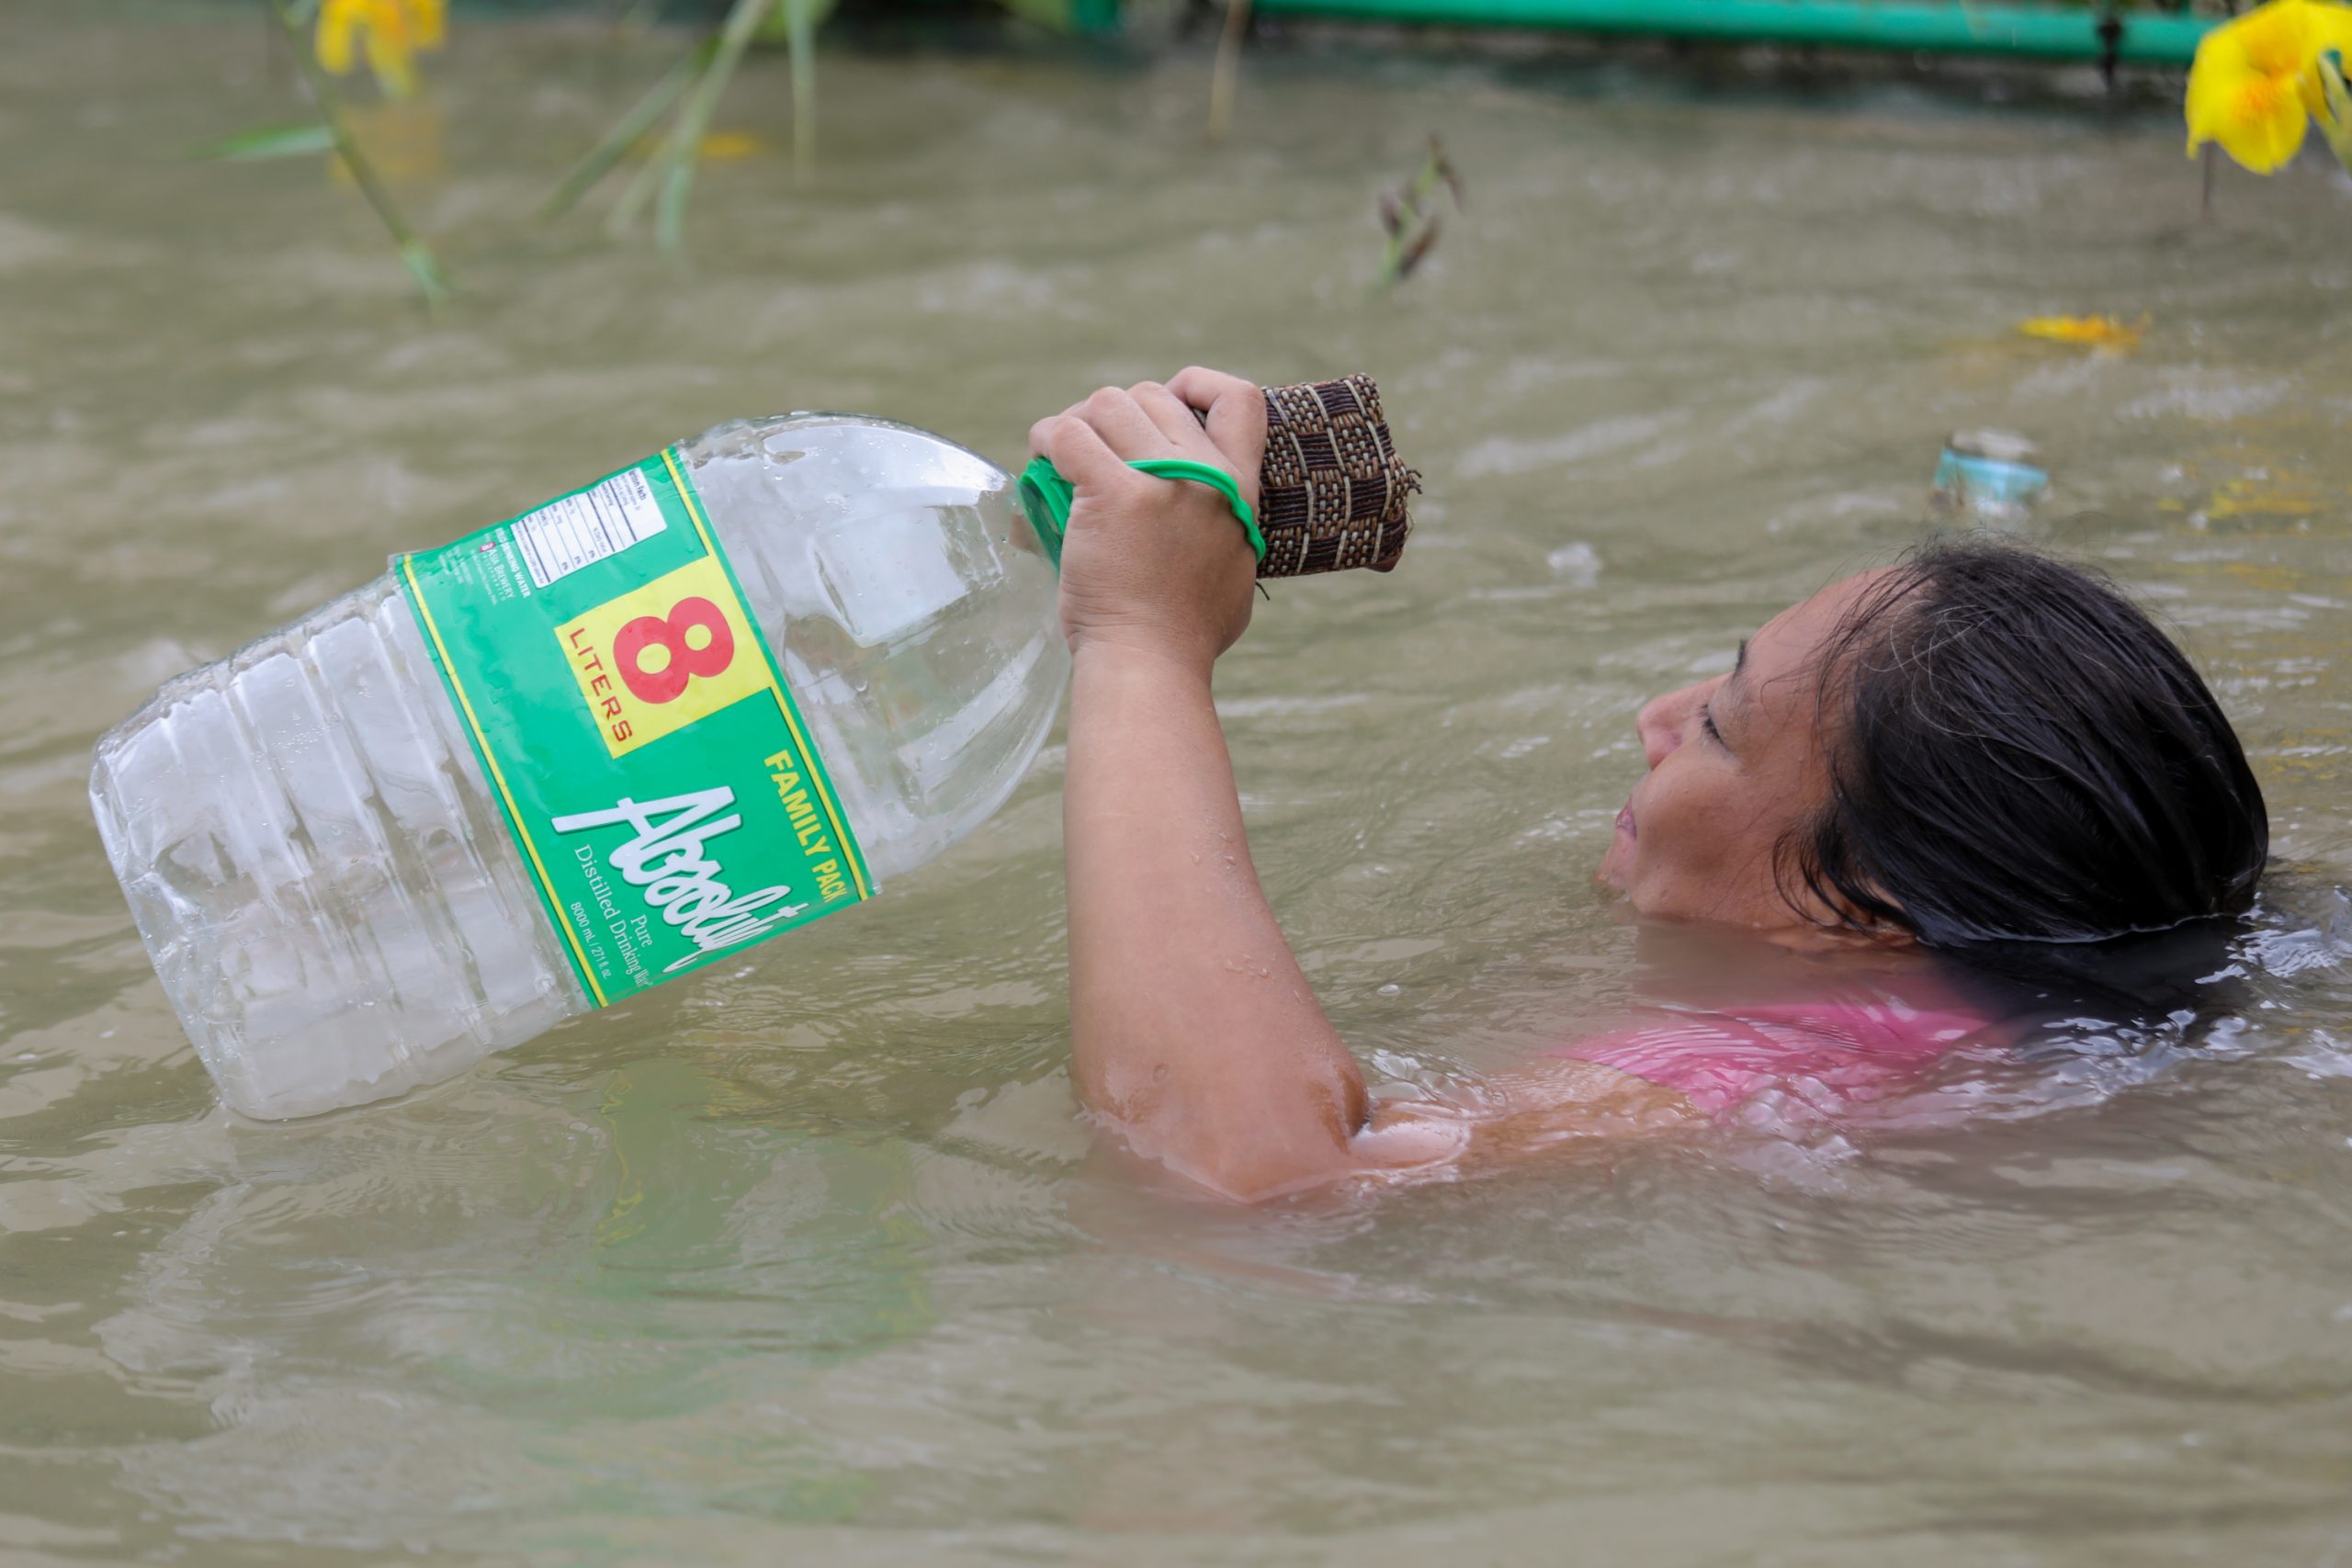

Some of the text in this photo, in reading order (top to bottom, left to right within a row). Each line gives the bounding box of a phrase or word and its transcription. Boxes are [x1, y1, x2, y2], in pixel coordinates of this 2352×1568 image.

[501, 541, 520, 573] DRINKING
[514, 570, 531, 598] WATER
[570, 627, 633, 742] LITERS
[613, 596, 735, 705] 8
[763, 749, 848, 903] FAMILY PACK
[571, 901, 590, 928] 8000
[582, 928, 596, 942] mL
[592, 946, 605, 963] 271
[574, 843, 621, 919] Distilled
[609, 919, 641, 975] Drinking
[630, 914, 653, 947] Pure
